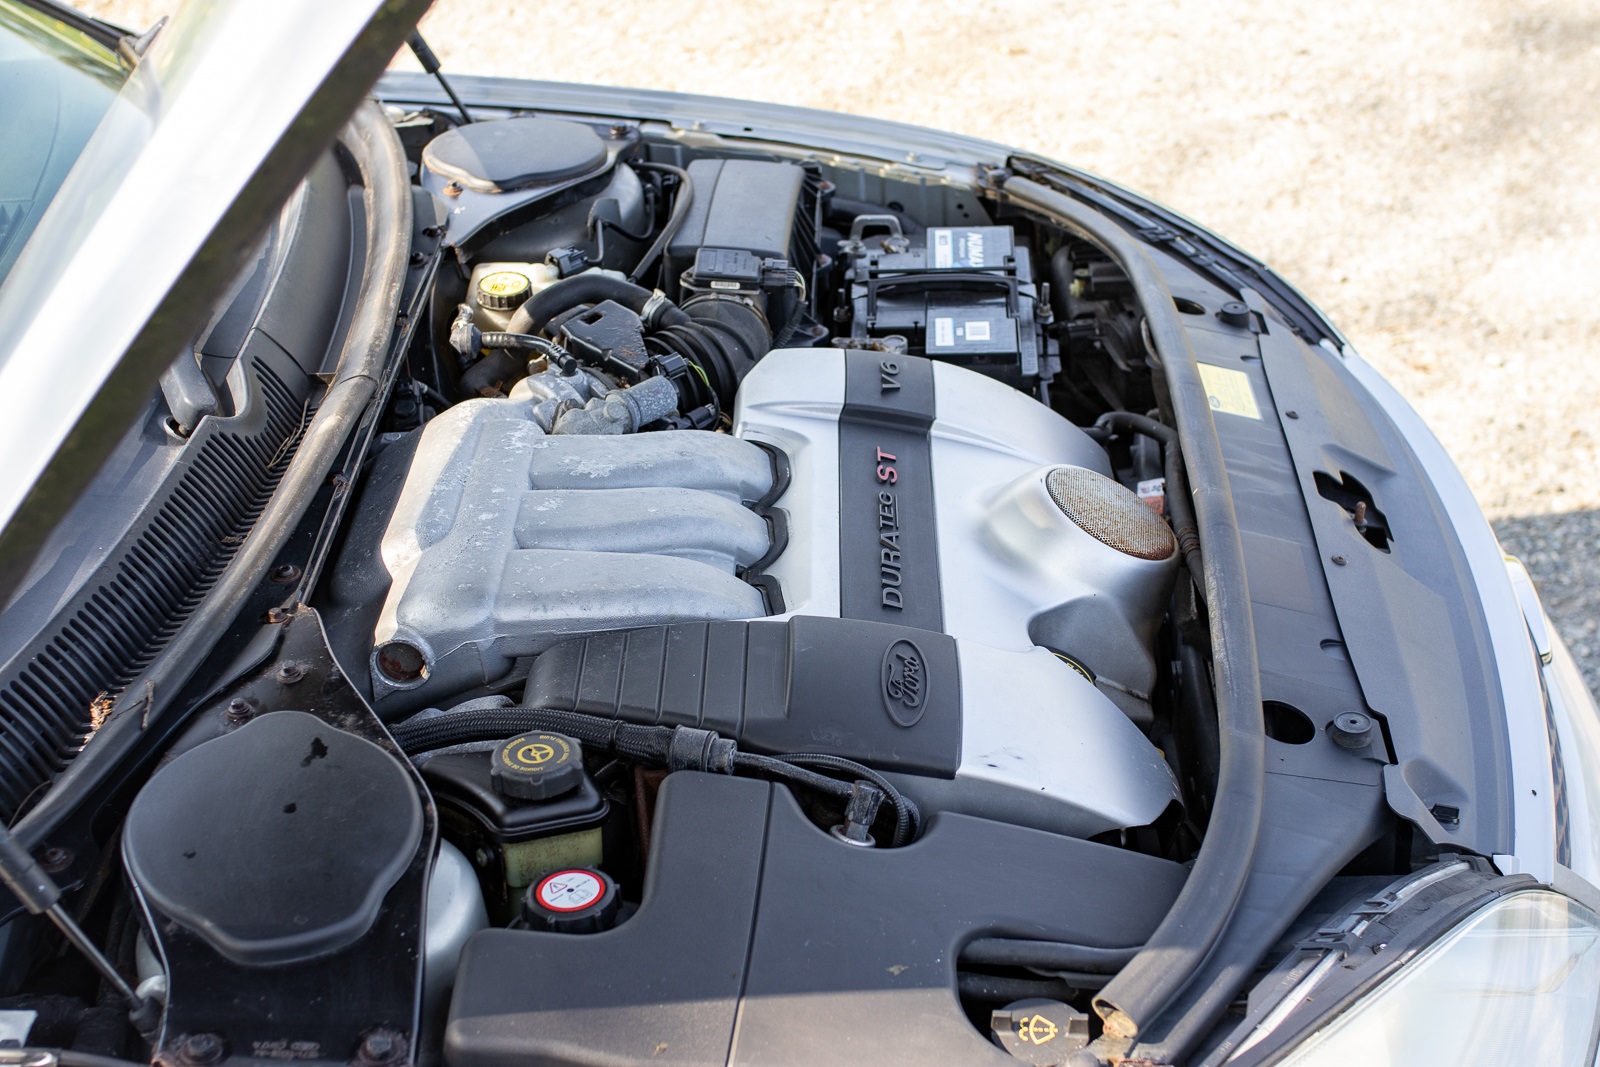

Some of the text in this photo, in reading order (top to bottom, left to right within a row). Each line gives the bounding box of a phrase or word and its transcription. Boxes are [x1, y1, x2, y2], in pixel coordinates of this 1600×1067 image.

[876, 359, 903, 611] DURATEC ST V6
[887, 652, 920, 708] Ford
